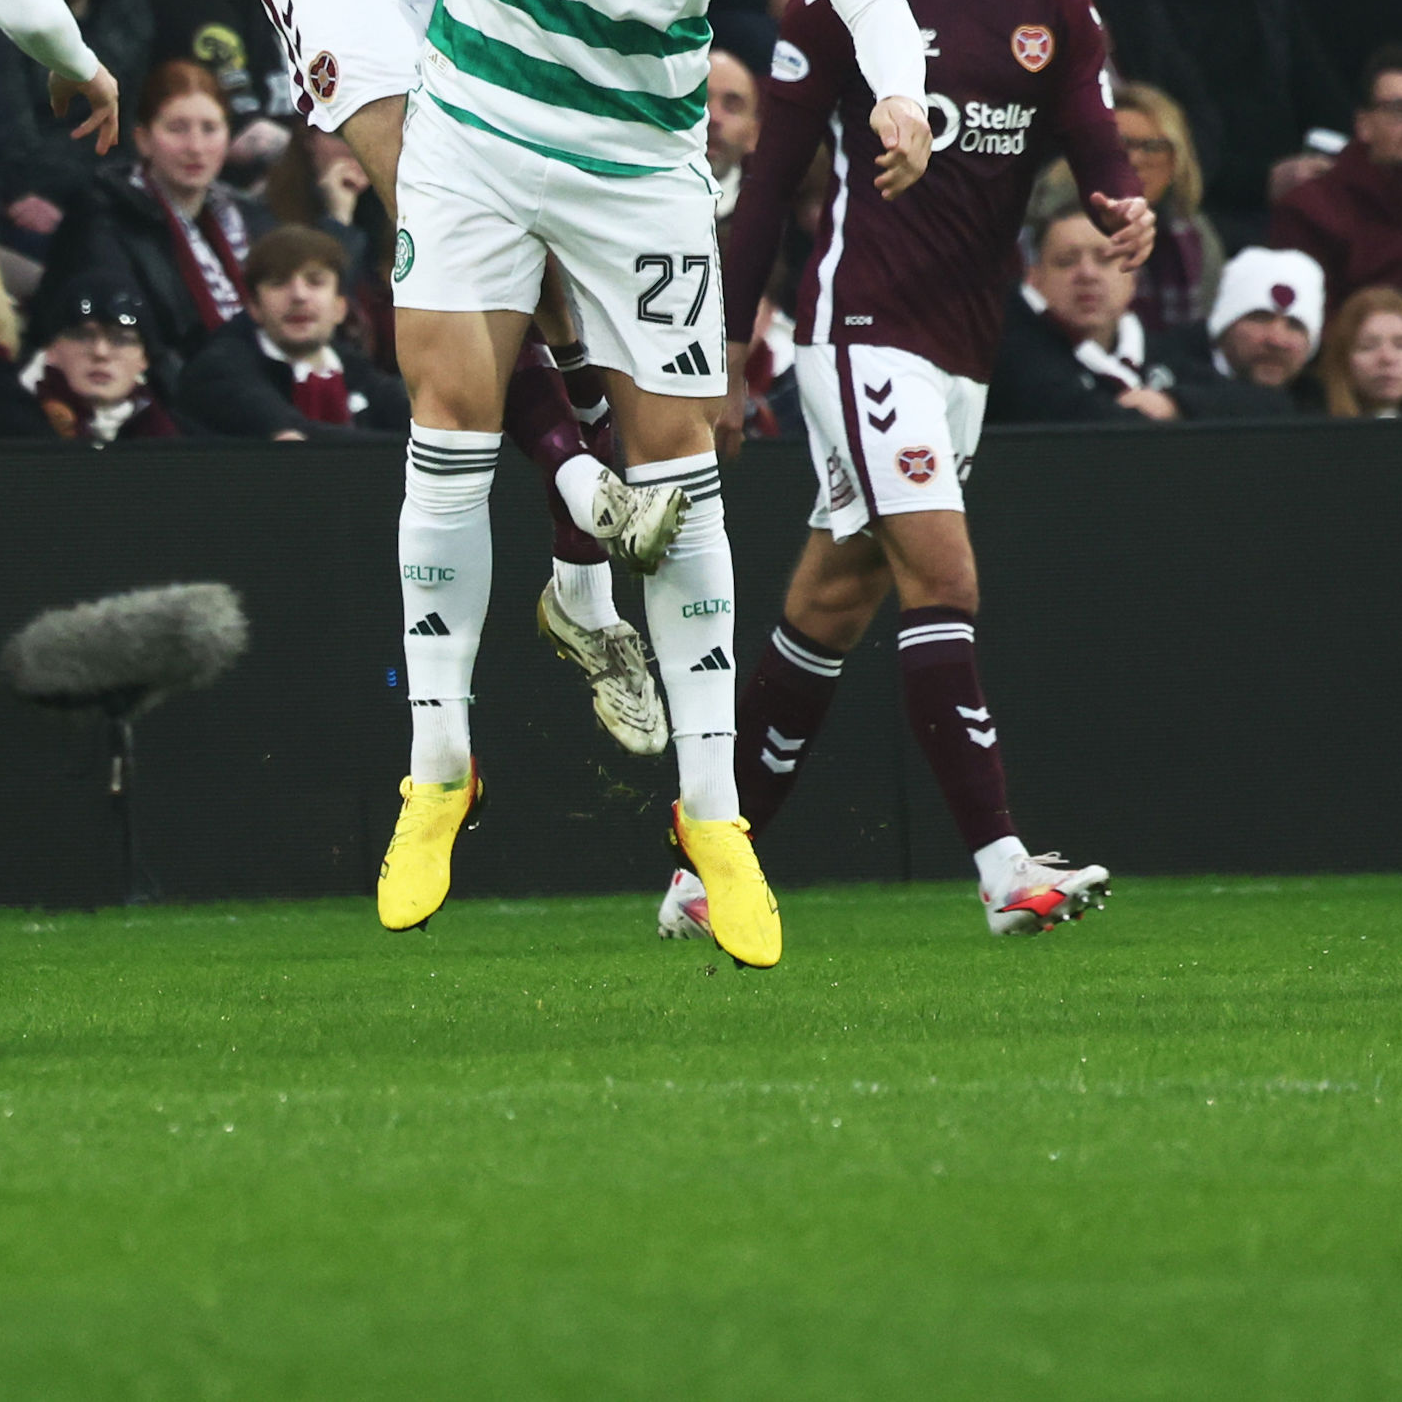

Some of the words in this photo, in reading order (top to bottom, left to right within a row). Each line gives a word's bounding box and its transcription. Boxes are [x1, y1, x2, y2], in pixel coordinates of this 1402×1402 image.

[965, 101, 1037, 129] Stellar
[635, 254, 710, 327] 27
[403, 564, 456, 582] CELTIC
[682, 599, 732, 618] CELTIC
